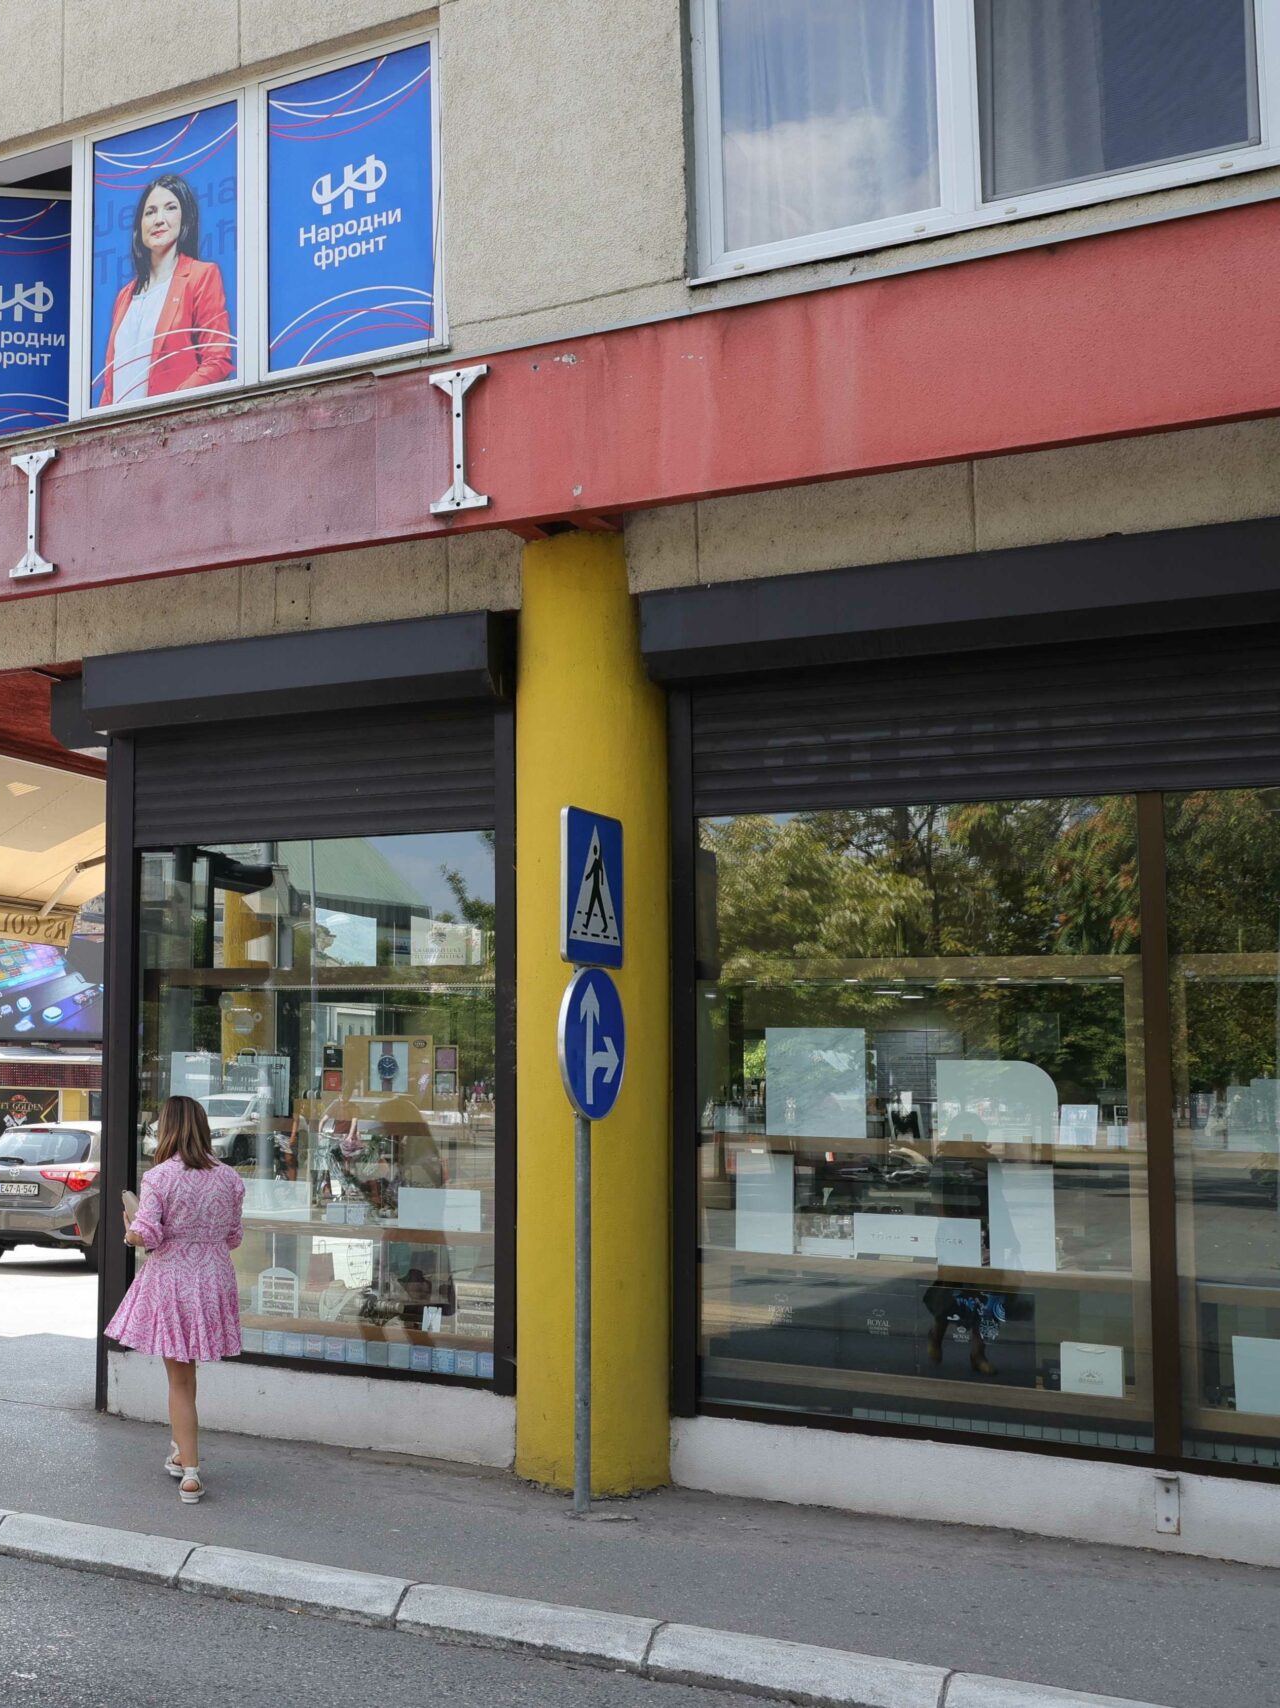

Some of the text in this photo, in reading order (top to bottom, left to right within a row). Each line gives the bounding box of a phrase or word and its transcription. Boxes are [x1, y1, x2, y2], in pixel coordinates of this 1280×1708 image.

[299, 207, 402, 248] Народни
[312, 235, 388, 271] фронт
[0, 1184, 37, 1194] E47-A-547
[768, 1305, 795, 1314] ROYAL
[867, 1319, 890, 1327] ROYAL
